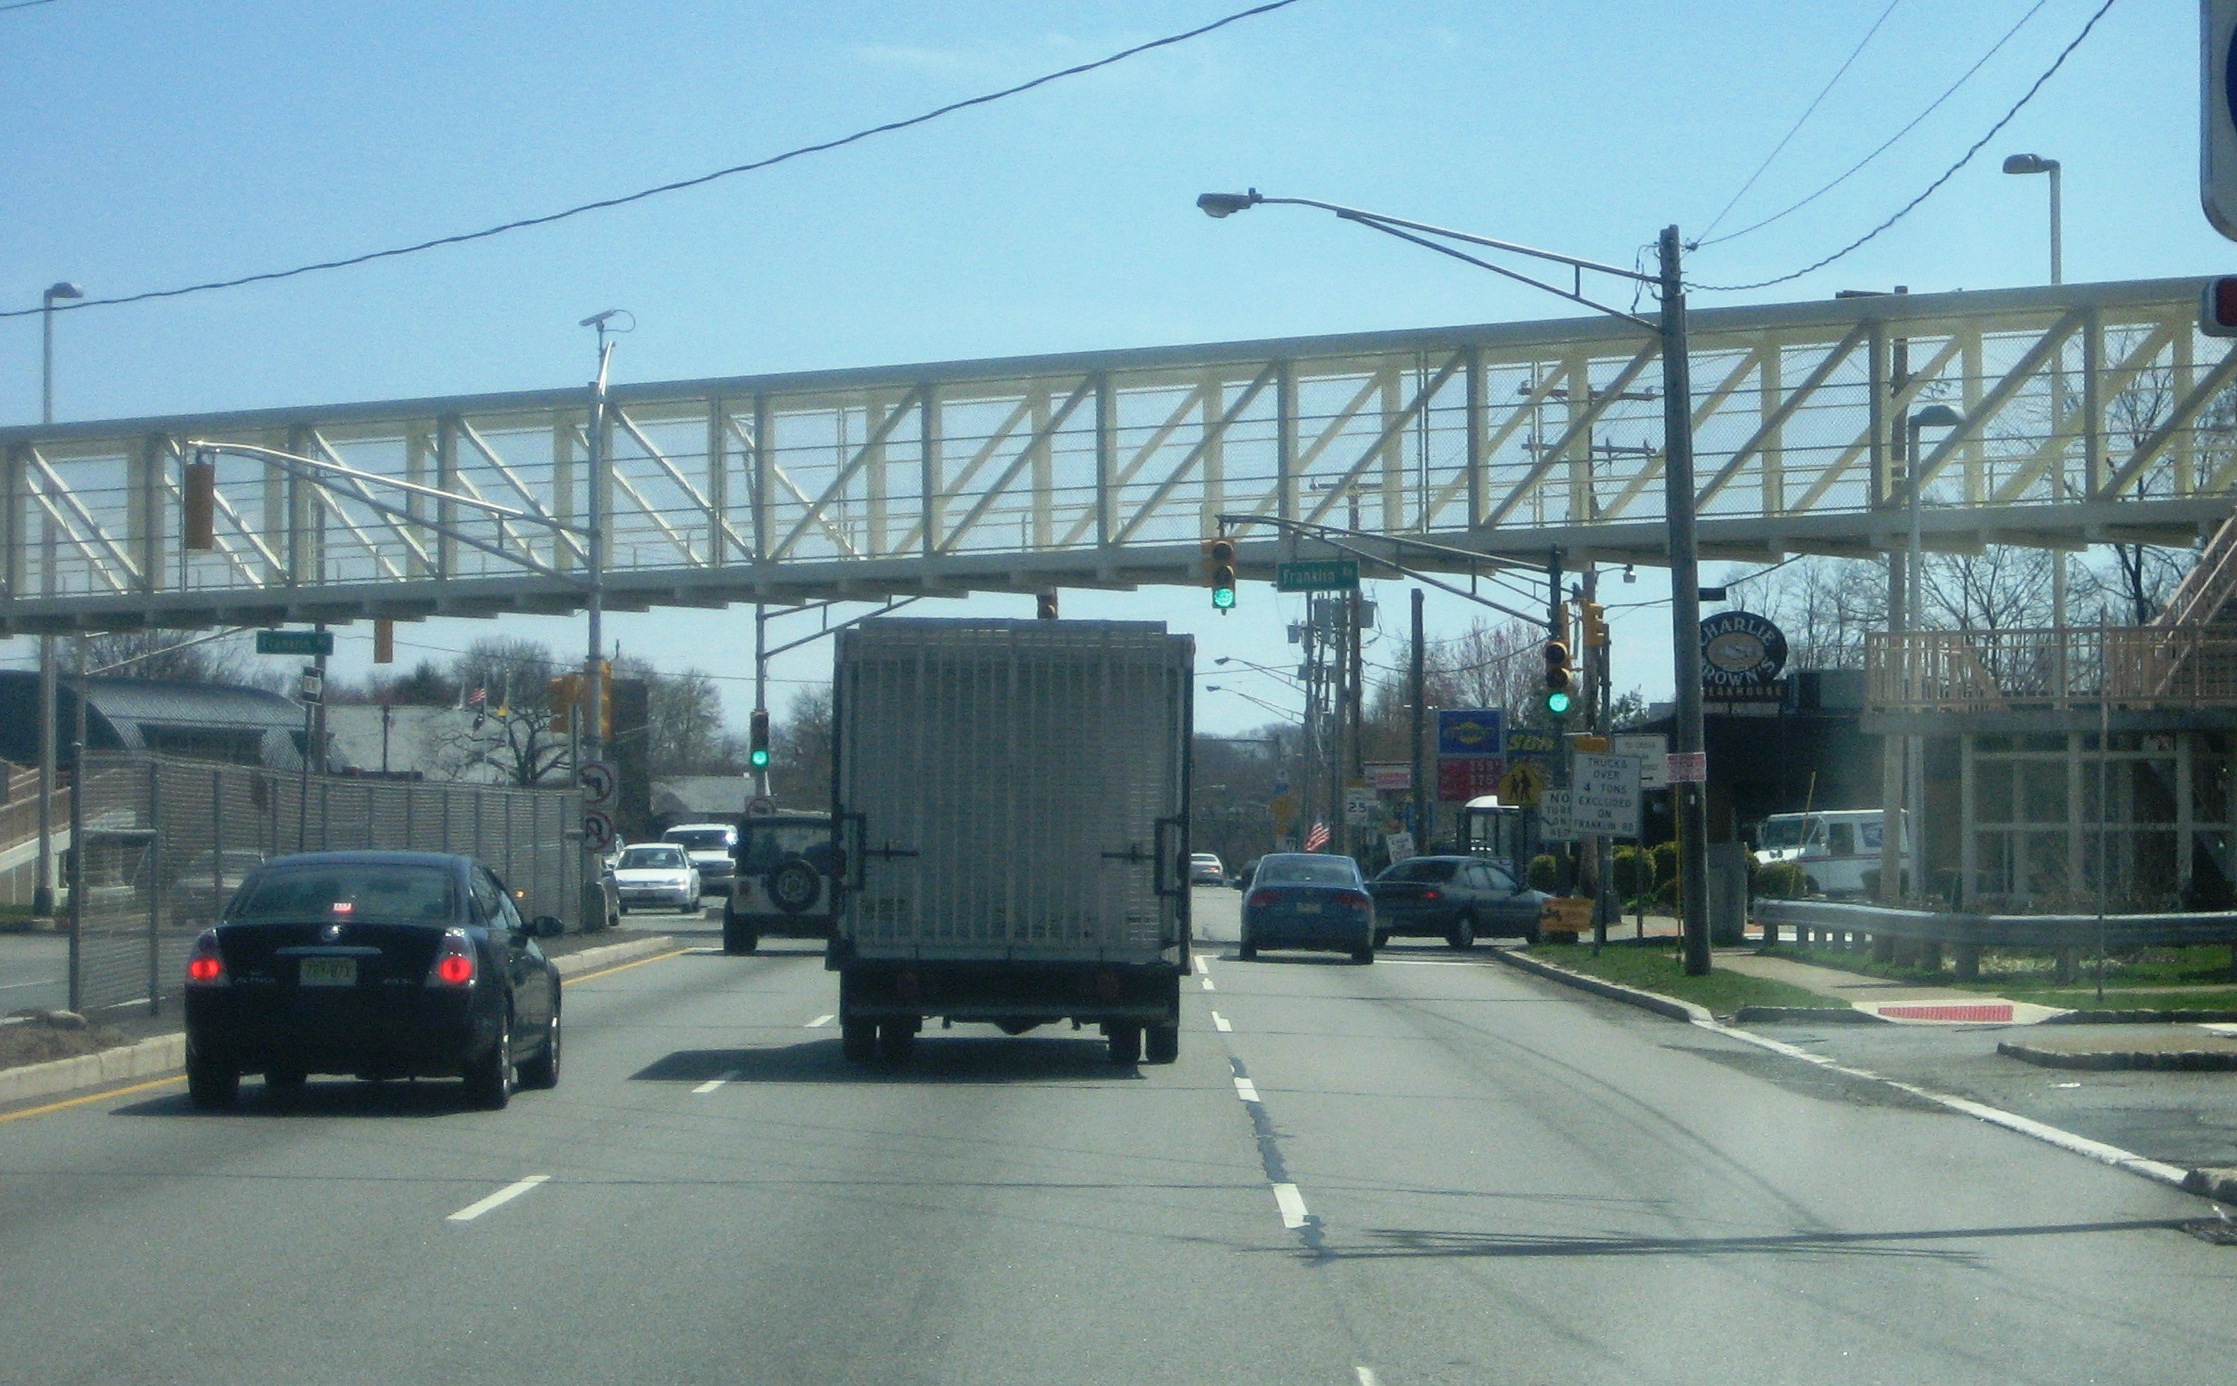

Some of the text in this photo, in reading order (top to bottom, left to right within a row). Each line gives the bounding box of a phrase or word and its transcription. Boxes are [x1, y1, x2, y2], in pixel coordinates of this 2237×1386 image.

[1282, 568, 1336, 584] Franklin
[1587, 757, 1628, 769] TRUCKS
[1593, 769, 1620, 780] OVER
[1583, 782, 1629, 795] 4 TONS
[1550, 793, 1570, 804] NO
[1578, 797, 1633, 808] EXCLUDED
[1348, 801, 1367, 813] 25
[1598, 808, 1612, 818] ON
[1574, 819, 1617, 831] FRANKLIN
